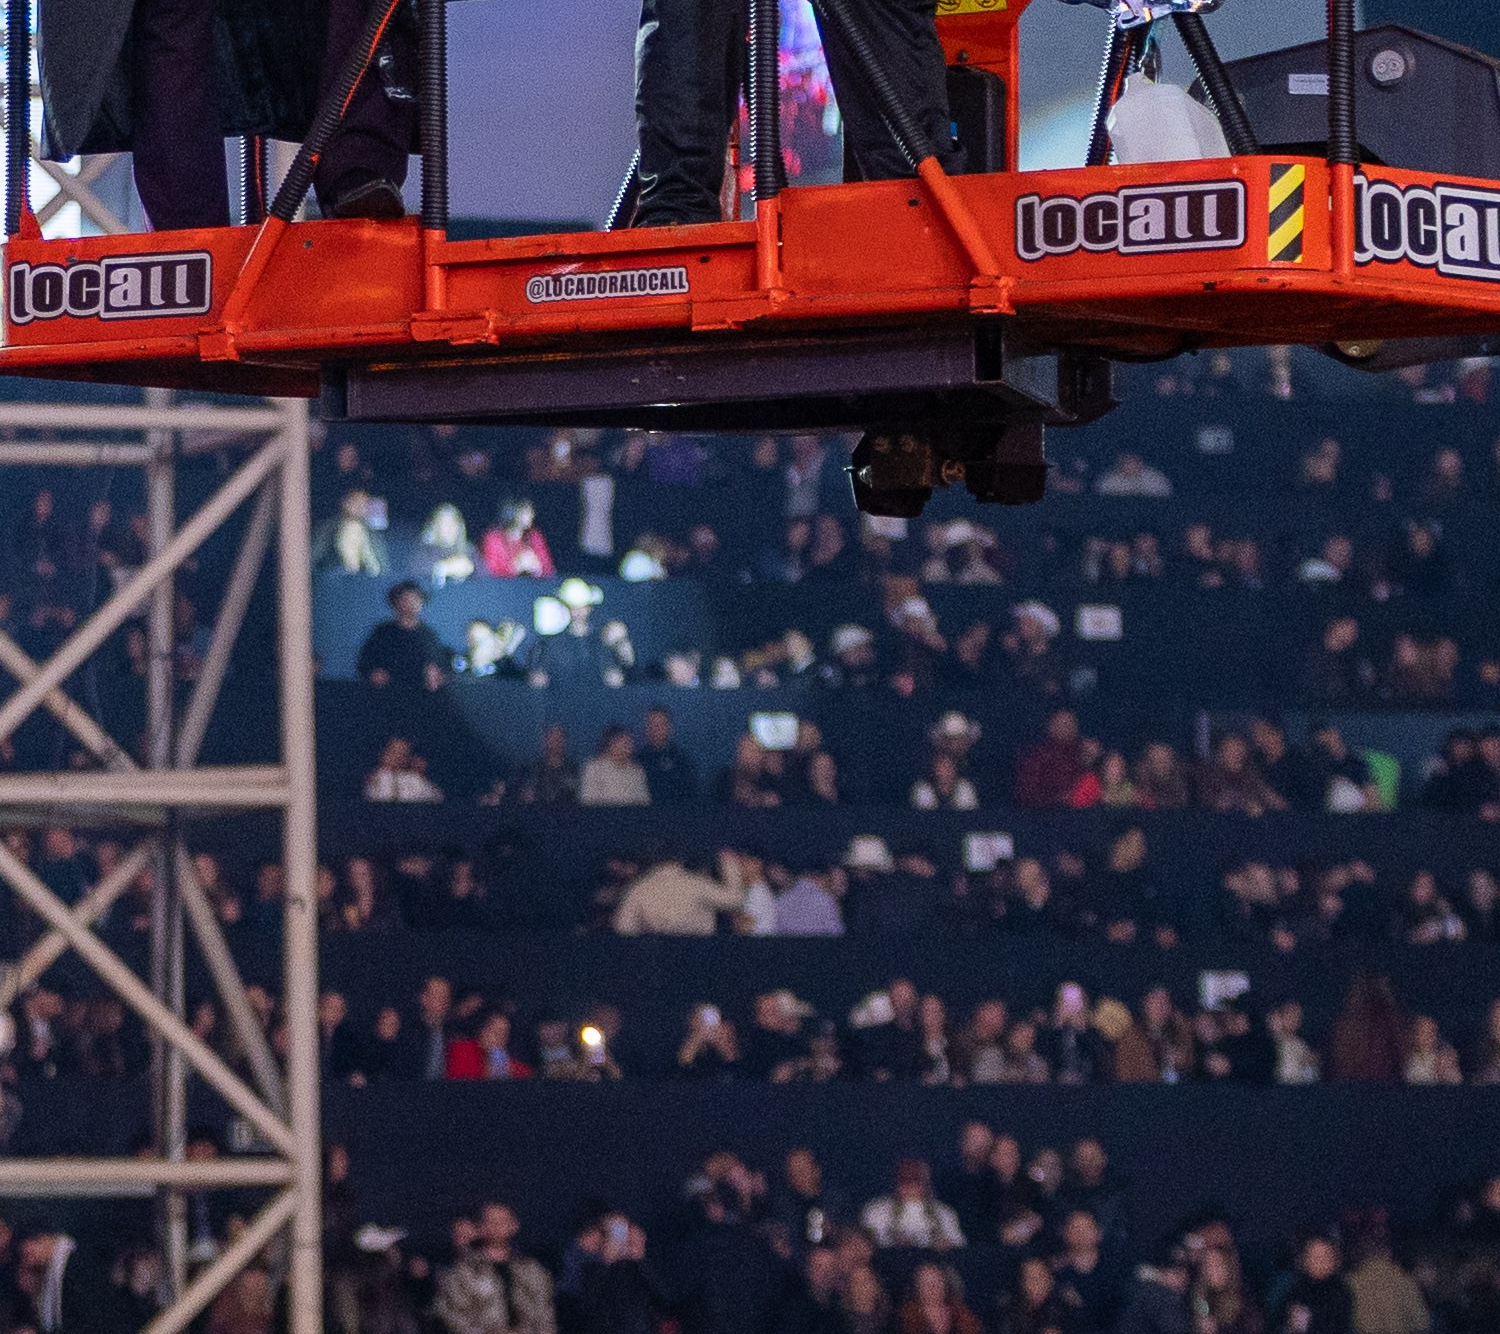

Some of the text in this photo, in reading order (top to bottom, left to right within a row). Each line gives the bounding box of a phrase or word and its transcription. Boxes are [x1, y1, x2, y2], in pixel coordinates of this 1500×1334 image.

[1021, 193, 1222, 255] locall
[11, 263, 193, 320] locall
[528, 269, 687, 300] @LOCADORALOCALL
